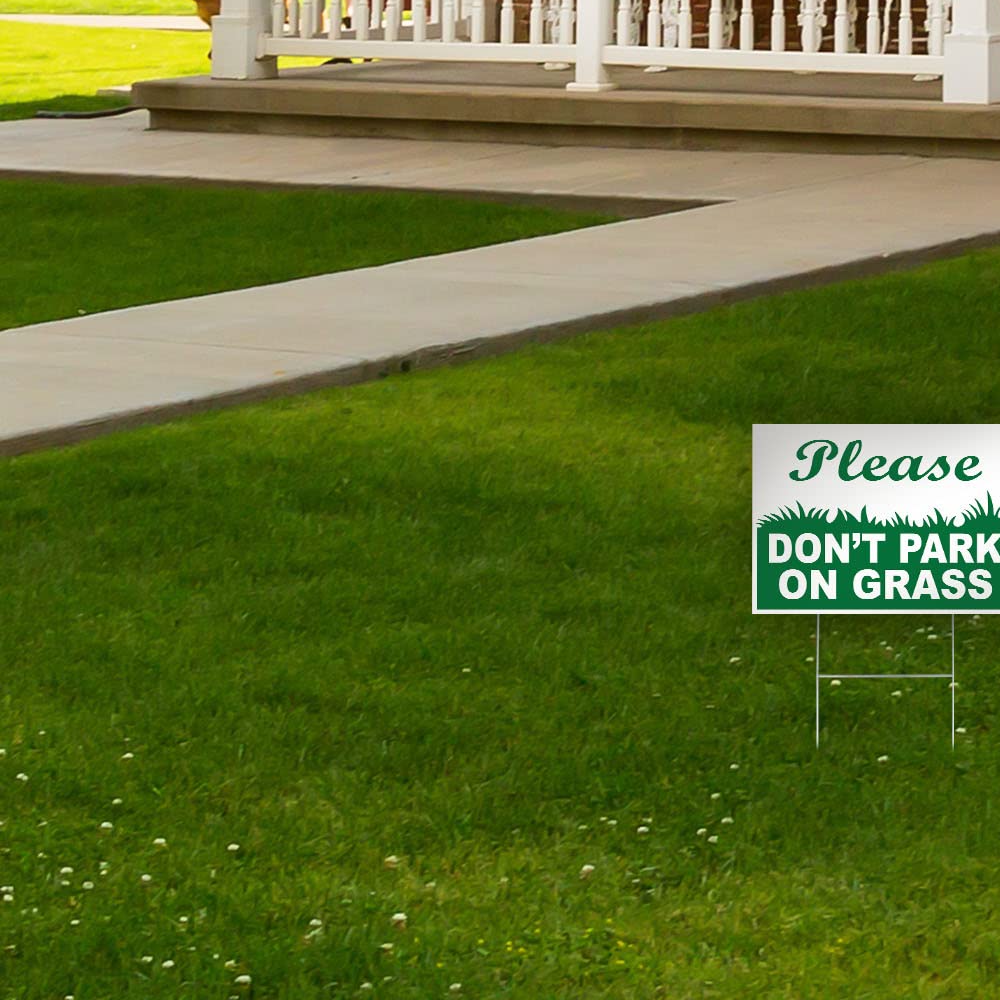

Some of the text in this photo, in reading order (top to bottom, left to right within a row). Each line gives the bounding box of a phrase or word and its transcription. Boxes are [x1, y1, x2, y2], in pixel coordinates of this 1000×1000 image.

[788, 439, 983, 482] Please
[768, 533, 886, 563] DON'T
[778, 569, 993, 599] ON GRASS
